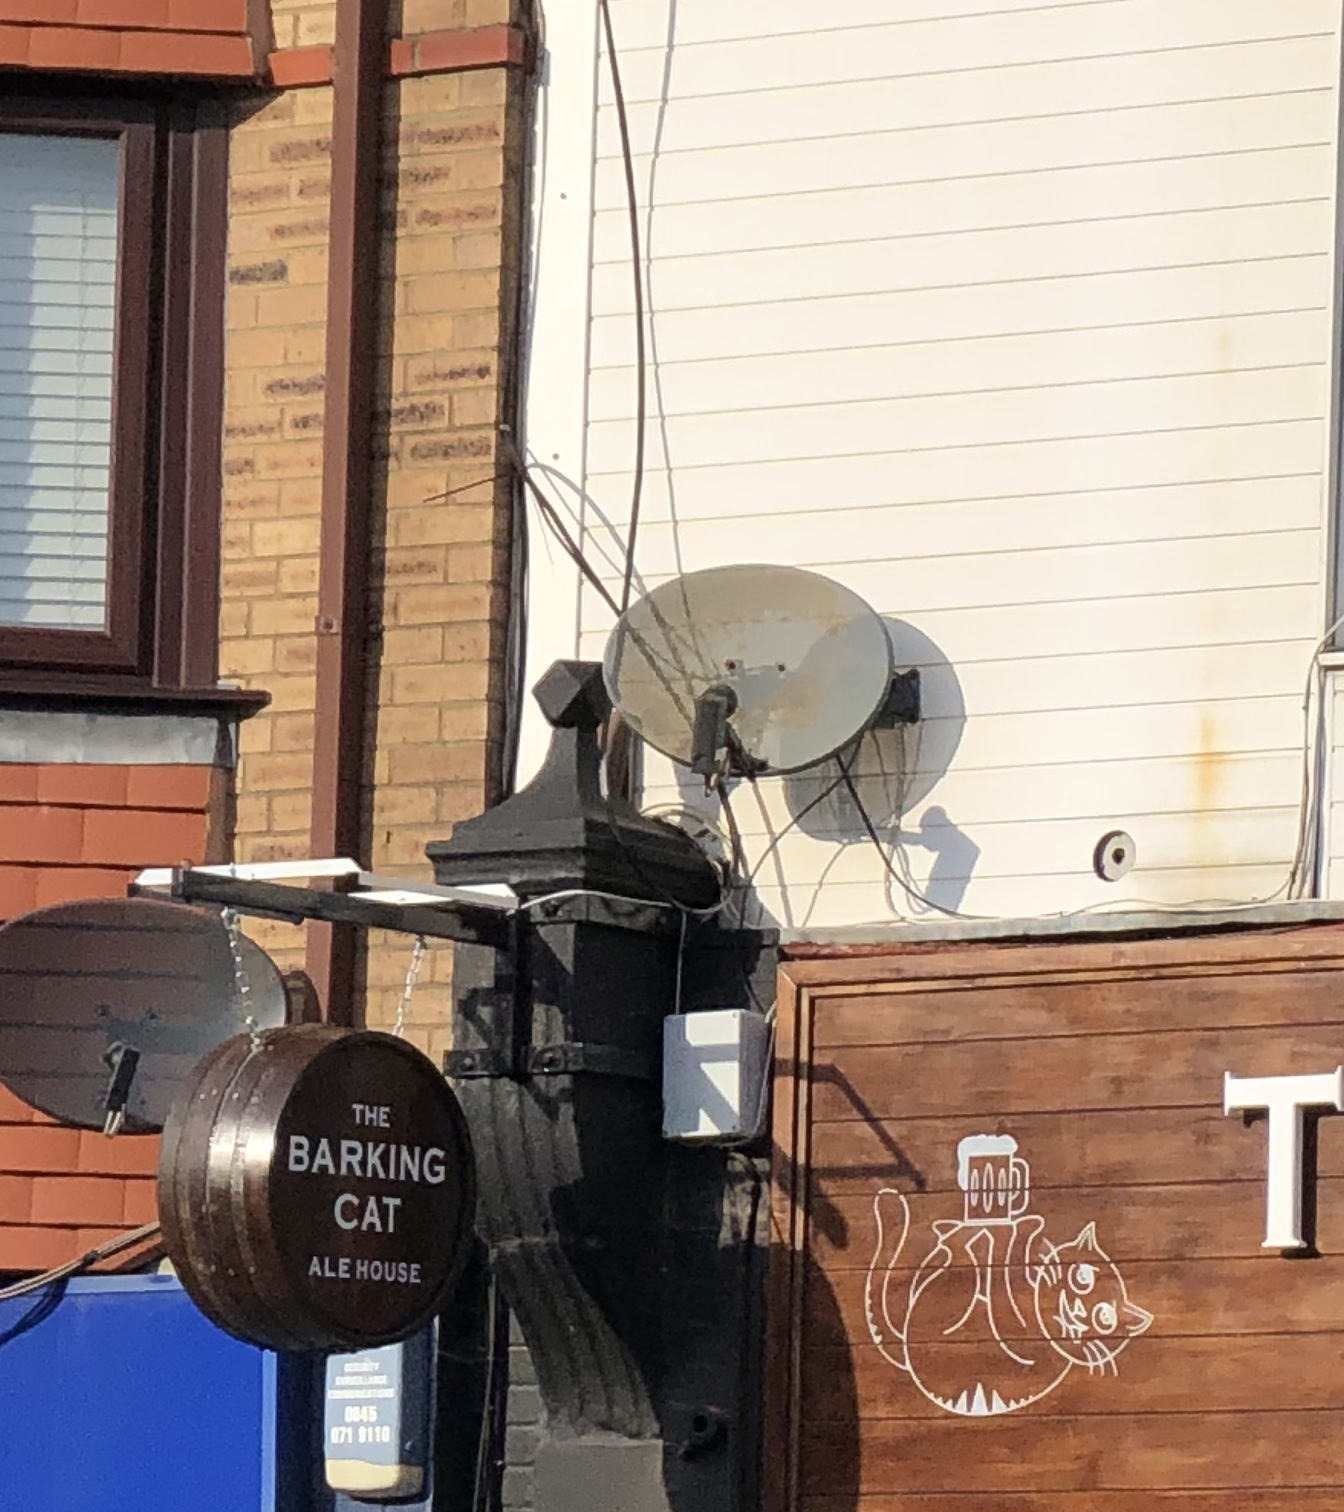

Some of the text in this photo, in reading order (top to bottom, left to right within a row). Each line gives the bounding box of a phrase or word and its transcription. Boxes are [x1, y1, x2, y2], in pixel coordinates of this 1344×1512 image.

[351, 1103, 392, 1129] THE
[288, 1134, 447, 1185] BARKING
[333, 1192, 403, 1234] CAT
[308, 1255, 422, 1284] ALE HOUSE
